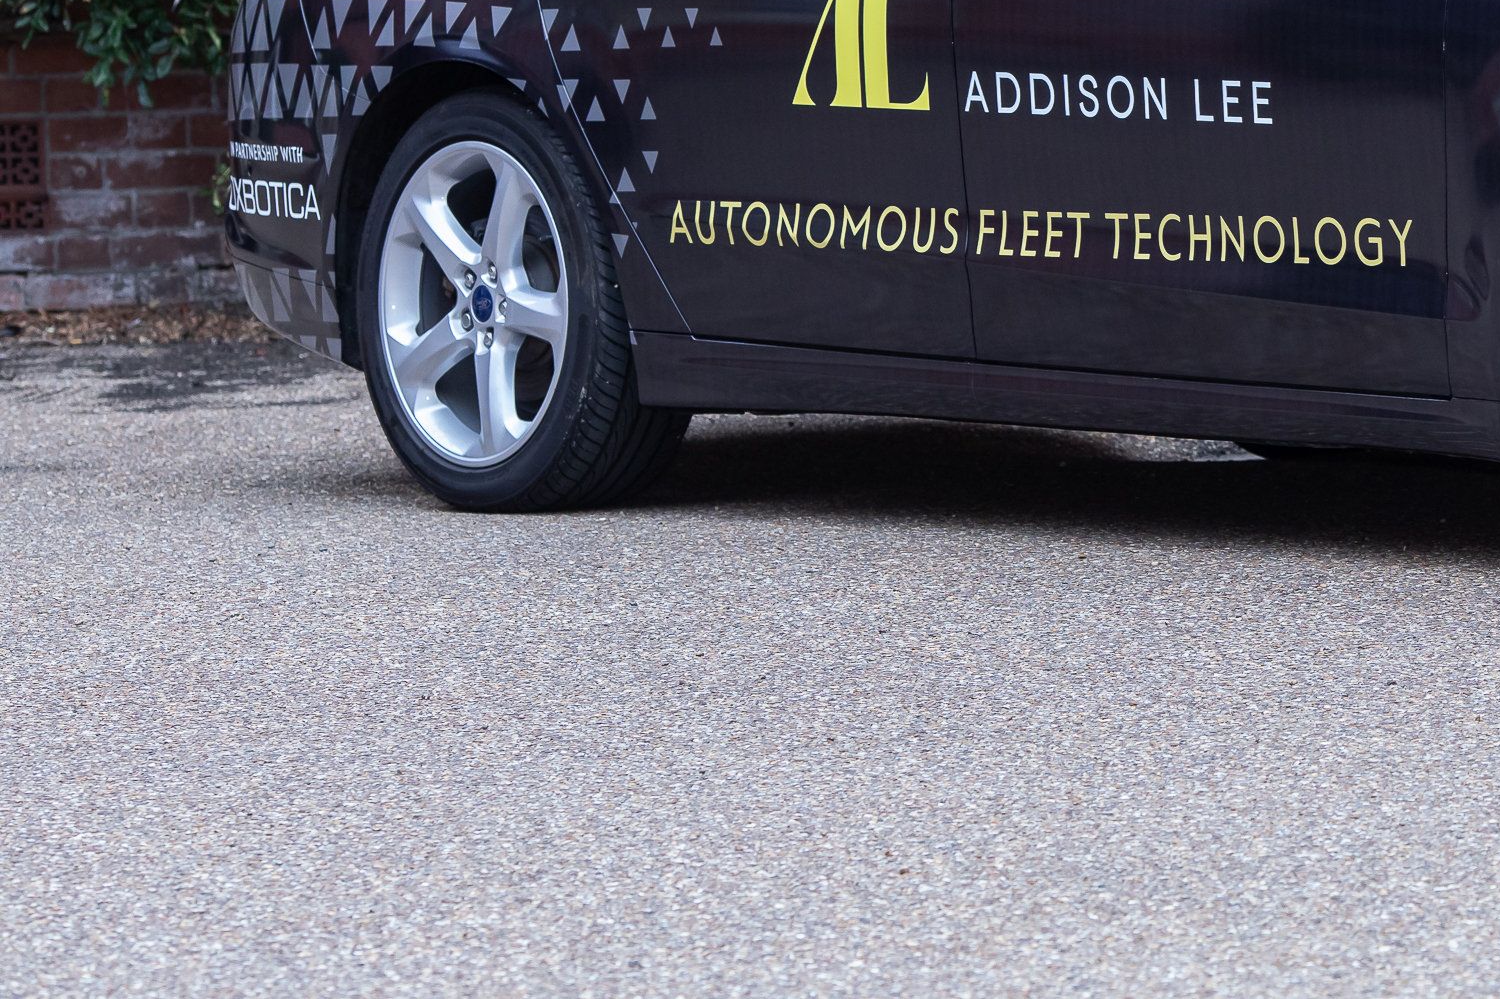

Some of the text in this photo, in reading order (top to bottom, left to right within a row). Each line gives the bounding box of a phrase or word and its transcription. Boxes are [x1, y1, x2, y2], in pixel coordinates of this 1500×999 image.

[964, 70, 1274, 125] ADDISON LEE
[235, 141, 279, 162] PARTNERSHIP
[280, 146, 304, 163] WITH
[229, 175, 321, 221] OXBOTICA
[669, 199, 1414, 267] AUTONOMOUS FLEET TECHNOLOGY
